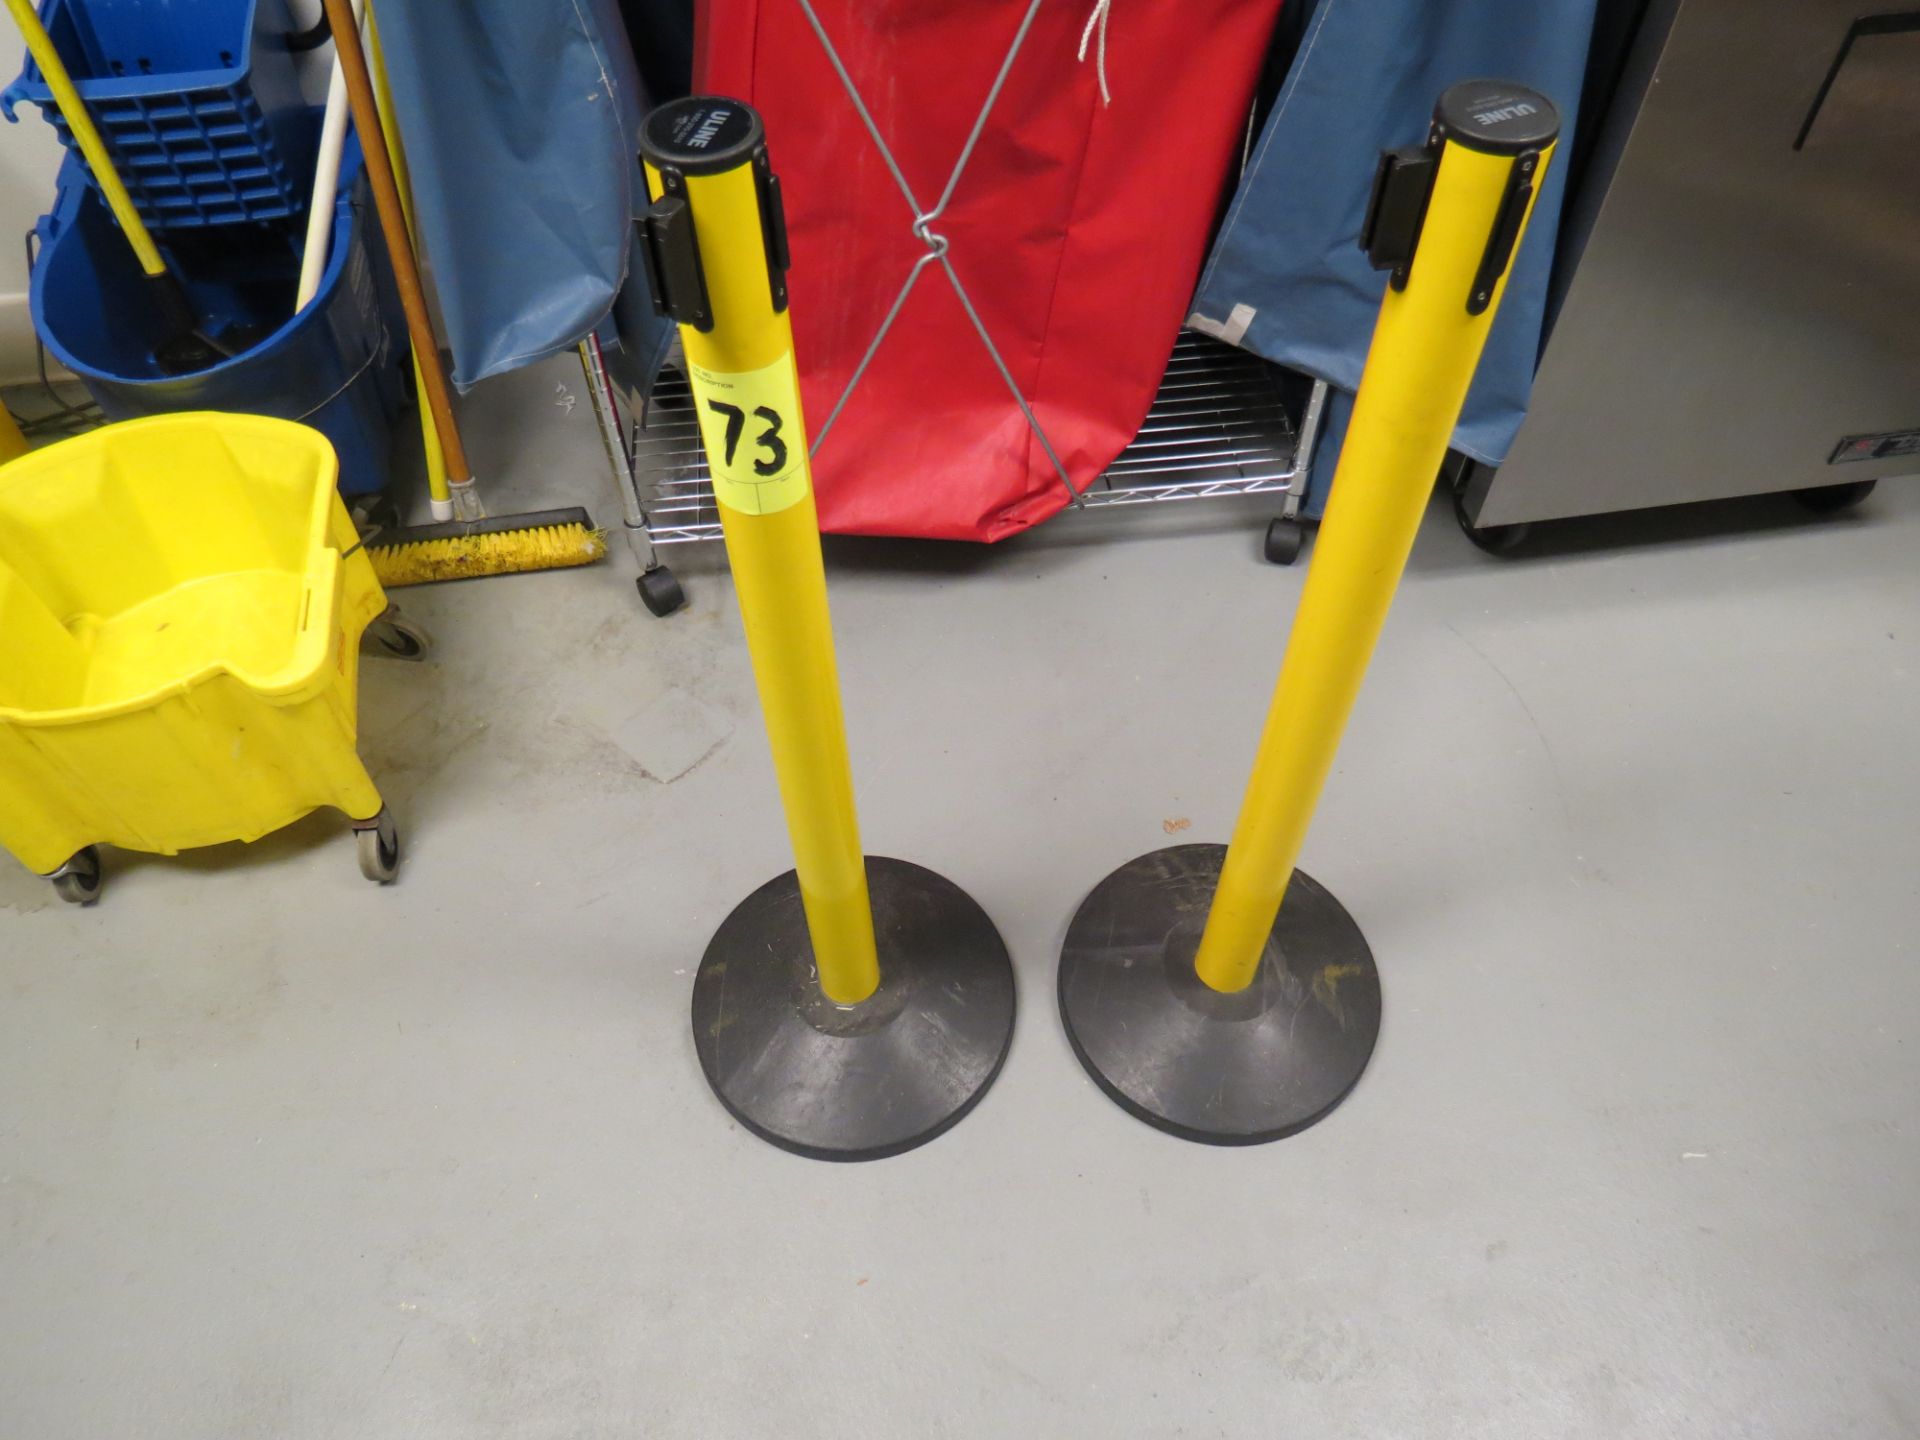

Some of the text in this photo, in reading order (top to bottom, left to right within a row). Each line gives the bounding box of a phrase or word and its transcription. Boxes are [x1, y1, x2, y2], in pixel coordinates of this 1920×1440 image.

[687, 110, 731, 148] ULINE
[1472, 103, 1537, 125] ULINE
[707, 398, 788, 476] 73
